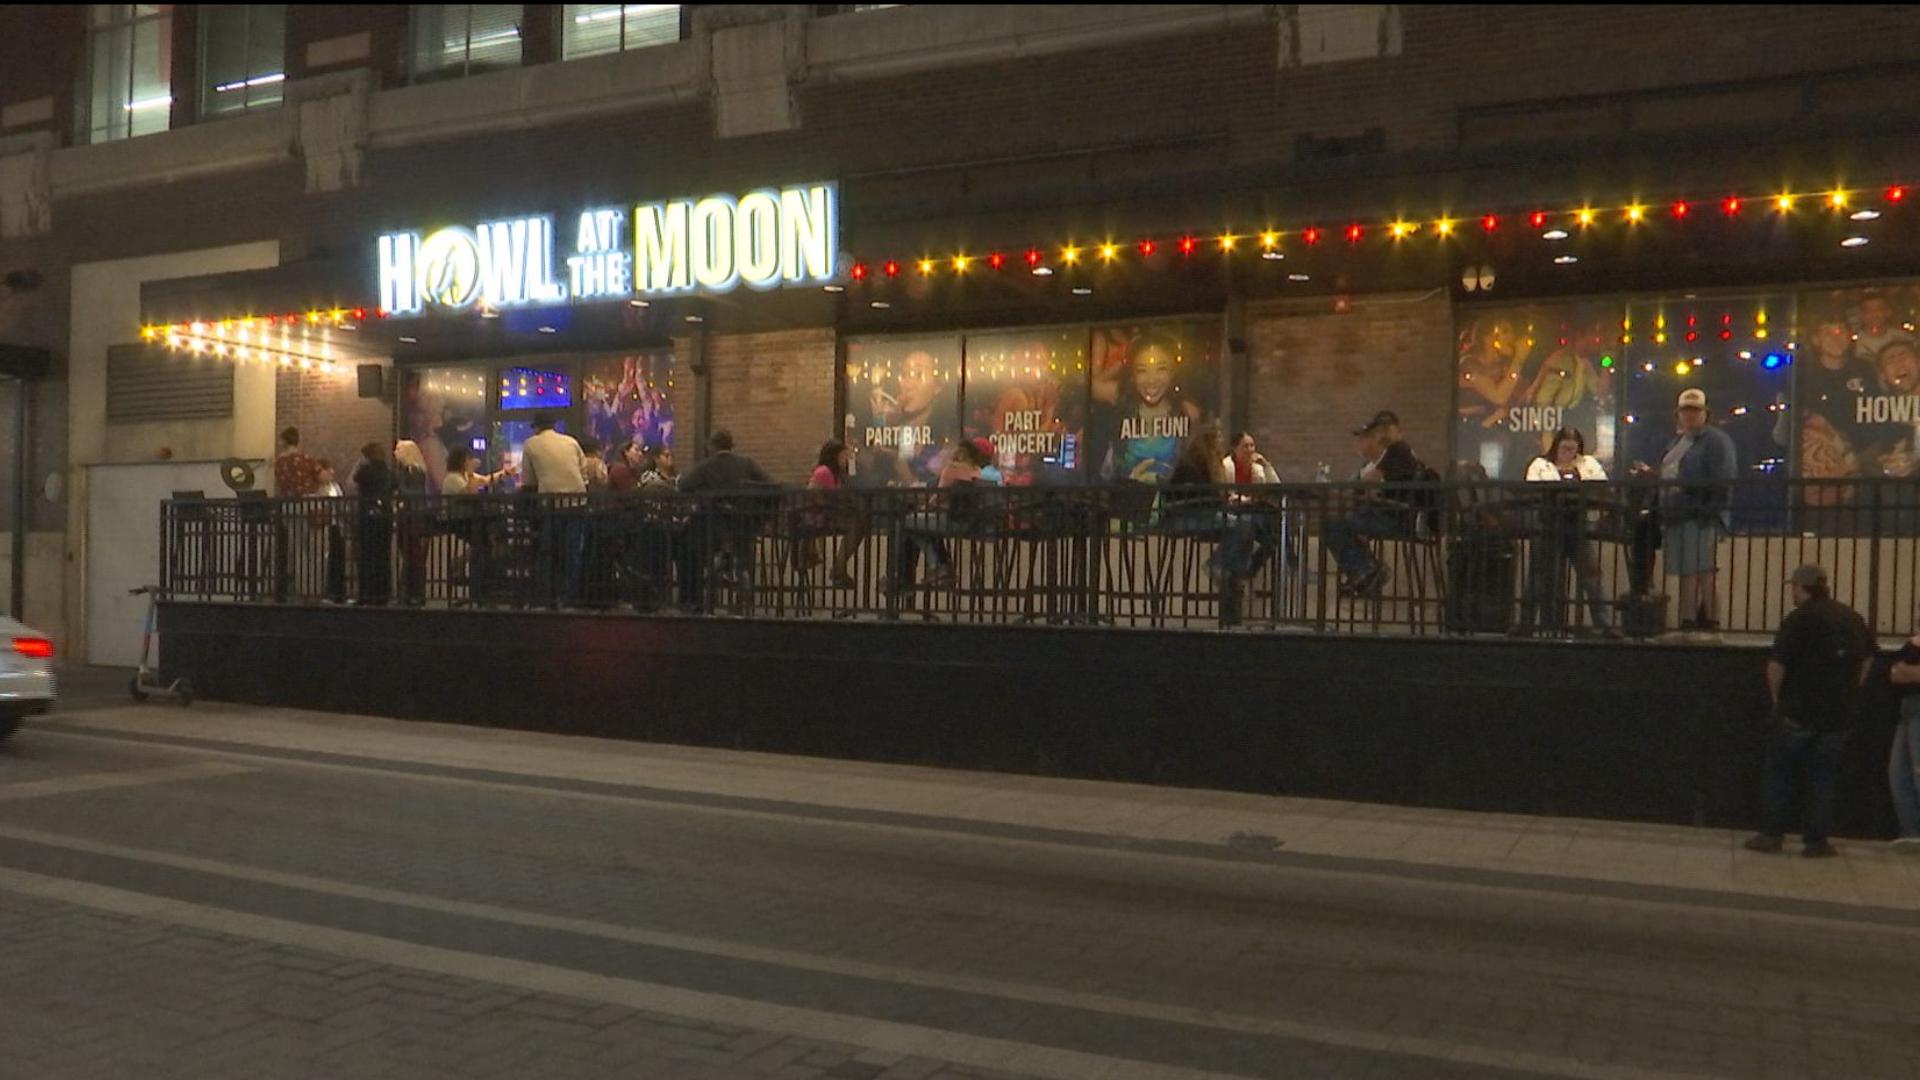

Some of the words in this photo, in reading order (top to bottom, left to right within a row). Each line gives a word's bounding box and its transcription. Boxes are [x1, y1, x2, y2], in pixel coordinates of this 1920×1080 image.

[577, 208, 624, 254] AT
[634, 186, 836, 292] MOON
[377, 214, 566, 314] HOWL
[566, 251, 632, 298] THE
[1004, 410, 1041, 431] PART
[1120, 418, 1148, 439] ALL
[1153, 416, 1189, 437] FUN!
[1509, 405, 1563, 433] SING!
[865, 427, 900, 446] PART
[903, 425, 935, 445] BAR.
[989, 432, 1057, 454] CONCERT.
